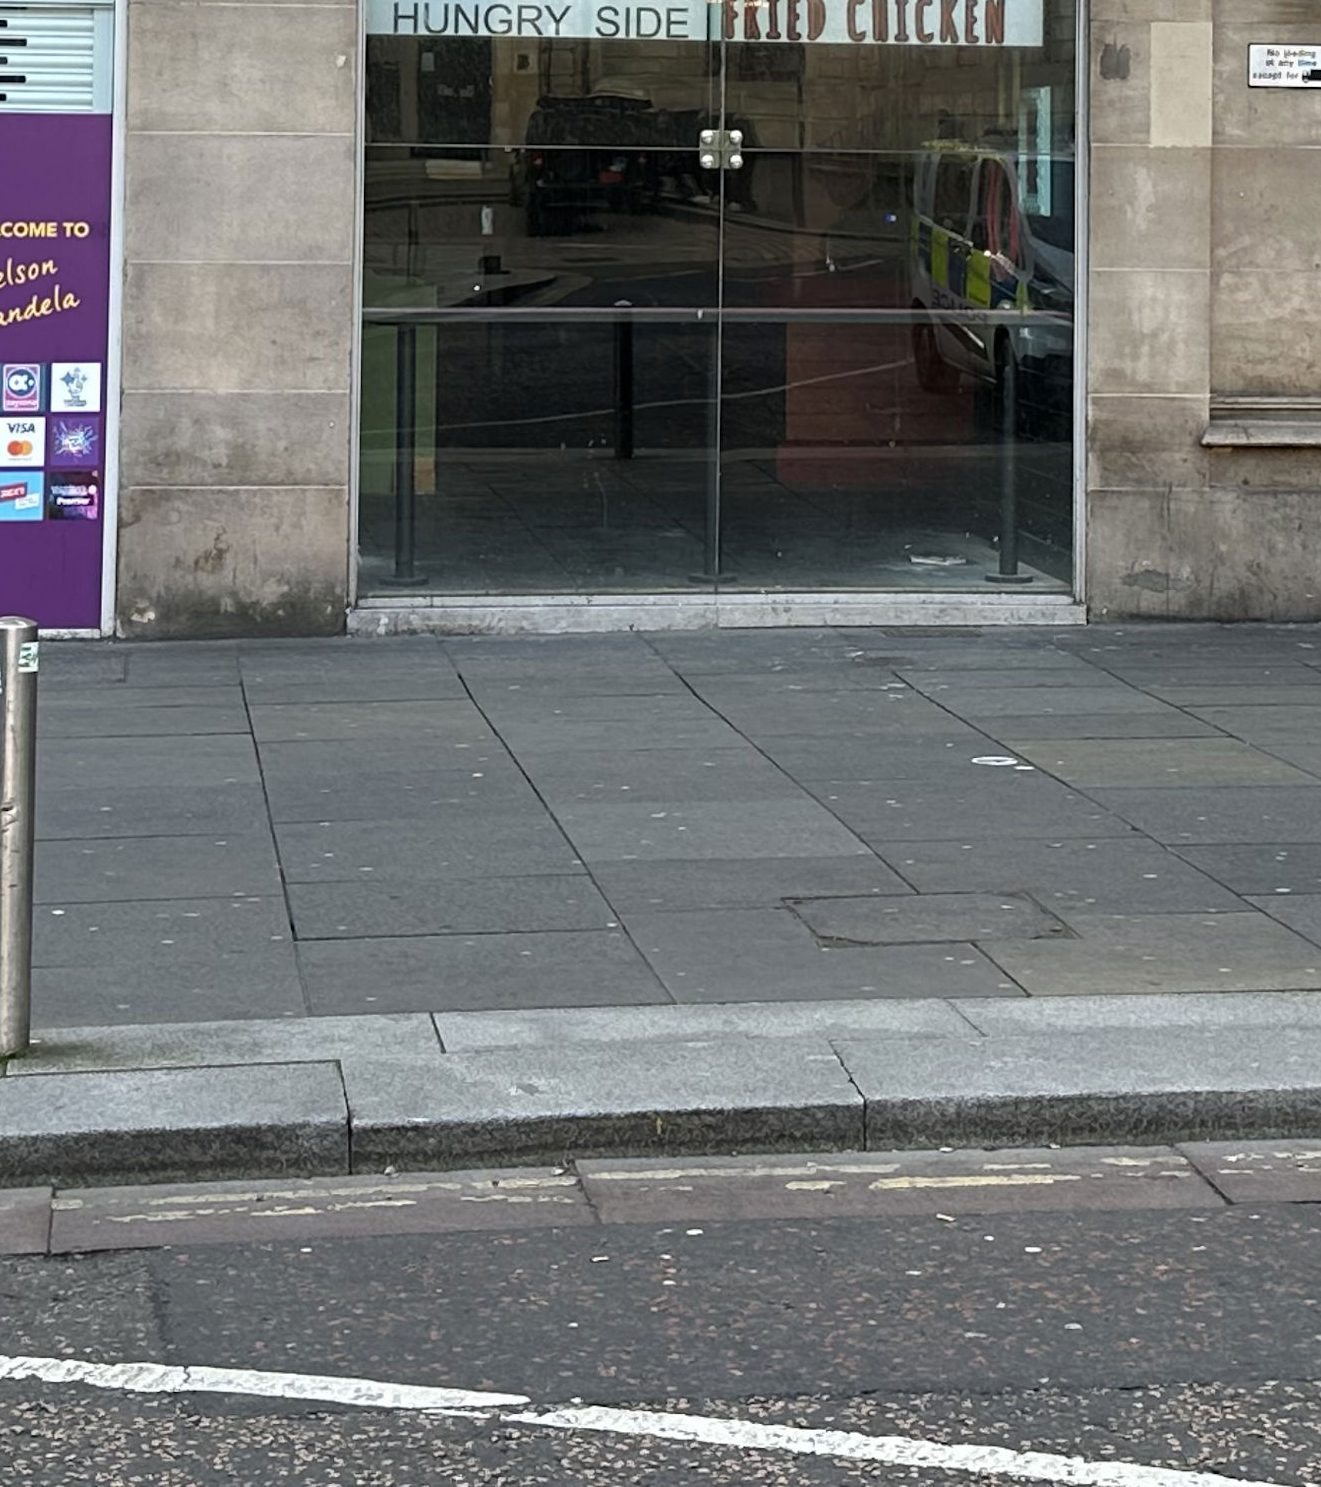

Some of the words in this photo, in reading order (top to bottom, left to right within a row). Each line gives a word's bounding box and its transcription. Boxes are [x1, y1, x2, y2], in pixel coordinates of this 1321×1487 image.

[393, 3, 571, 36] HUNGRY
[595, 6, 690, 39] SIDE
[62, 222, 90, 238] TO
[7, 423, 36, 434] VISA
